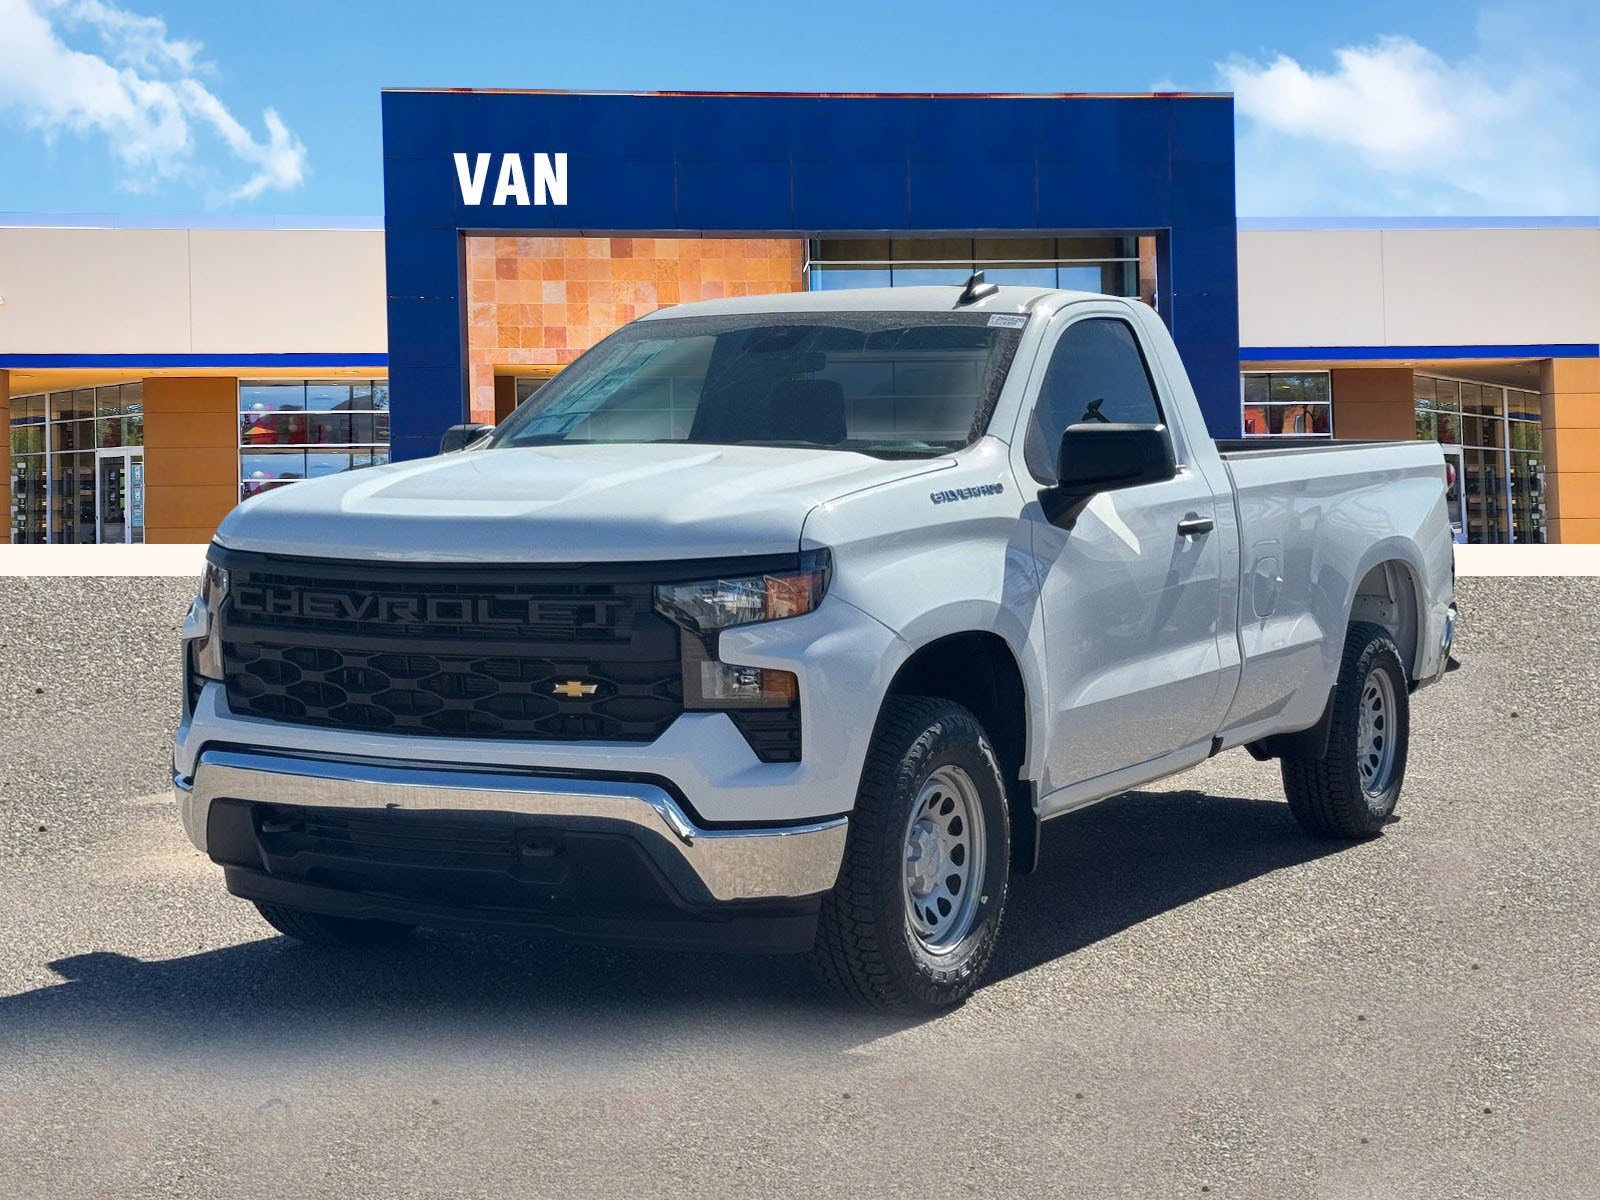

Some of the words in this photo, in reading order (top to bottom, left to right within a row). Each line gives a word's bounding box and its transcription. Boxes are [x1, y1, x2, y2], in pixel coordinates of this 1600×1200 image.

[453, 153, 568, 206] VAN
[929, 482, 1005, 505] SILVERADO
[232, 587, 629, 627] CHEVROLET
